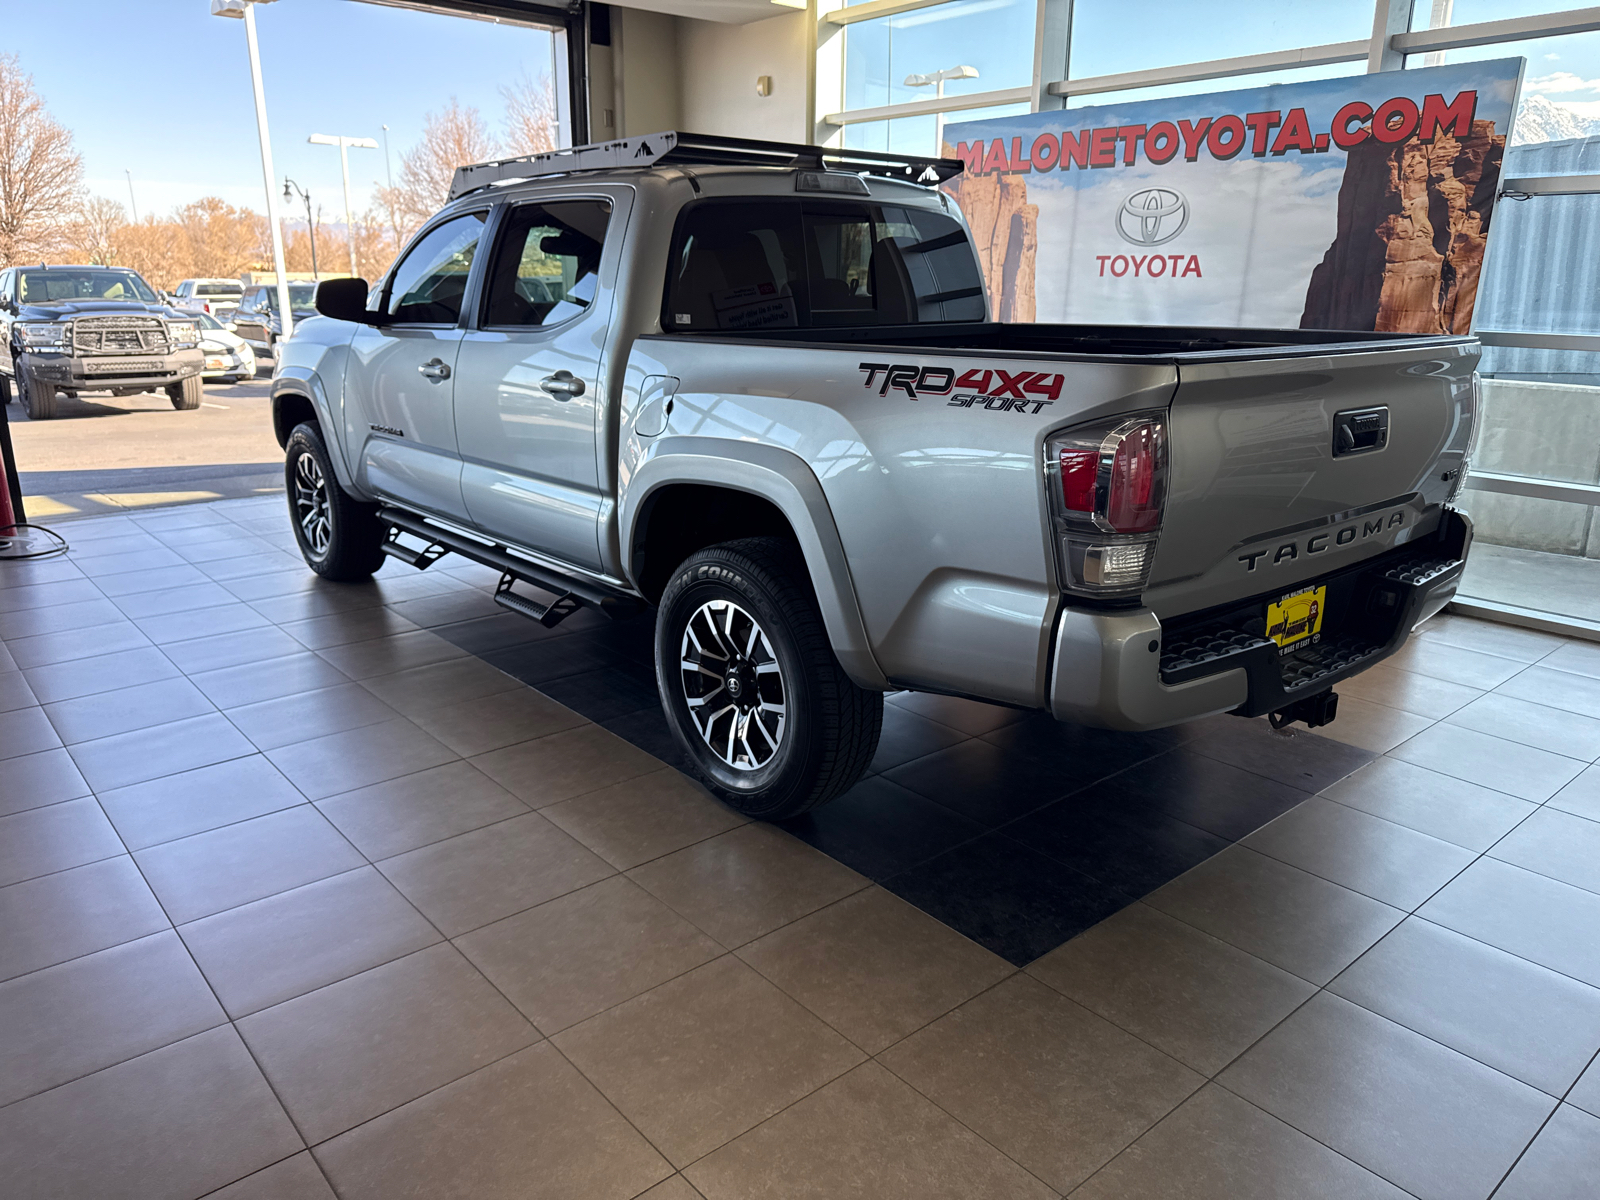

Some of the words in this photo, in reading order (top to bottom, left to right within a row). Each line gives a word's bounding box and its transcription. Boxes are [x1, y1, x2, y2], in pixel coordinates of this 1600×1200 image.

[957, 89, 1478, 177] MALONETOYOTA.COM
[1096, 253, 1203, 279] TOYOTA
[858, 362, 957, 401] TRD
[946, 393, 1054, 415] SPORT
[1237, 510, 1407, 573] TACOMA
[1310, 604, 1317, 614] 32
[1283, 643, 1296, 655] MAKE
[1295, 641, 1300, 650] IT
[1299, 637, 1311, 649] EASY
